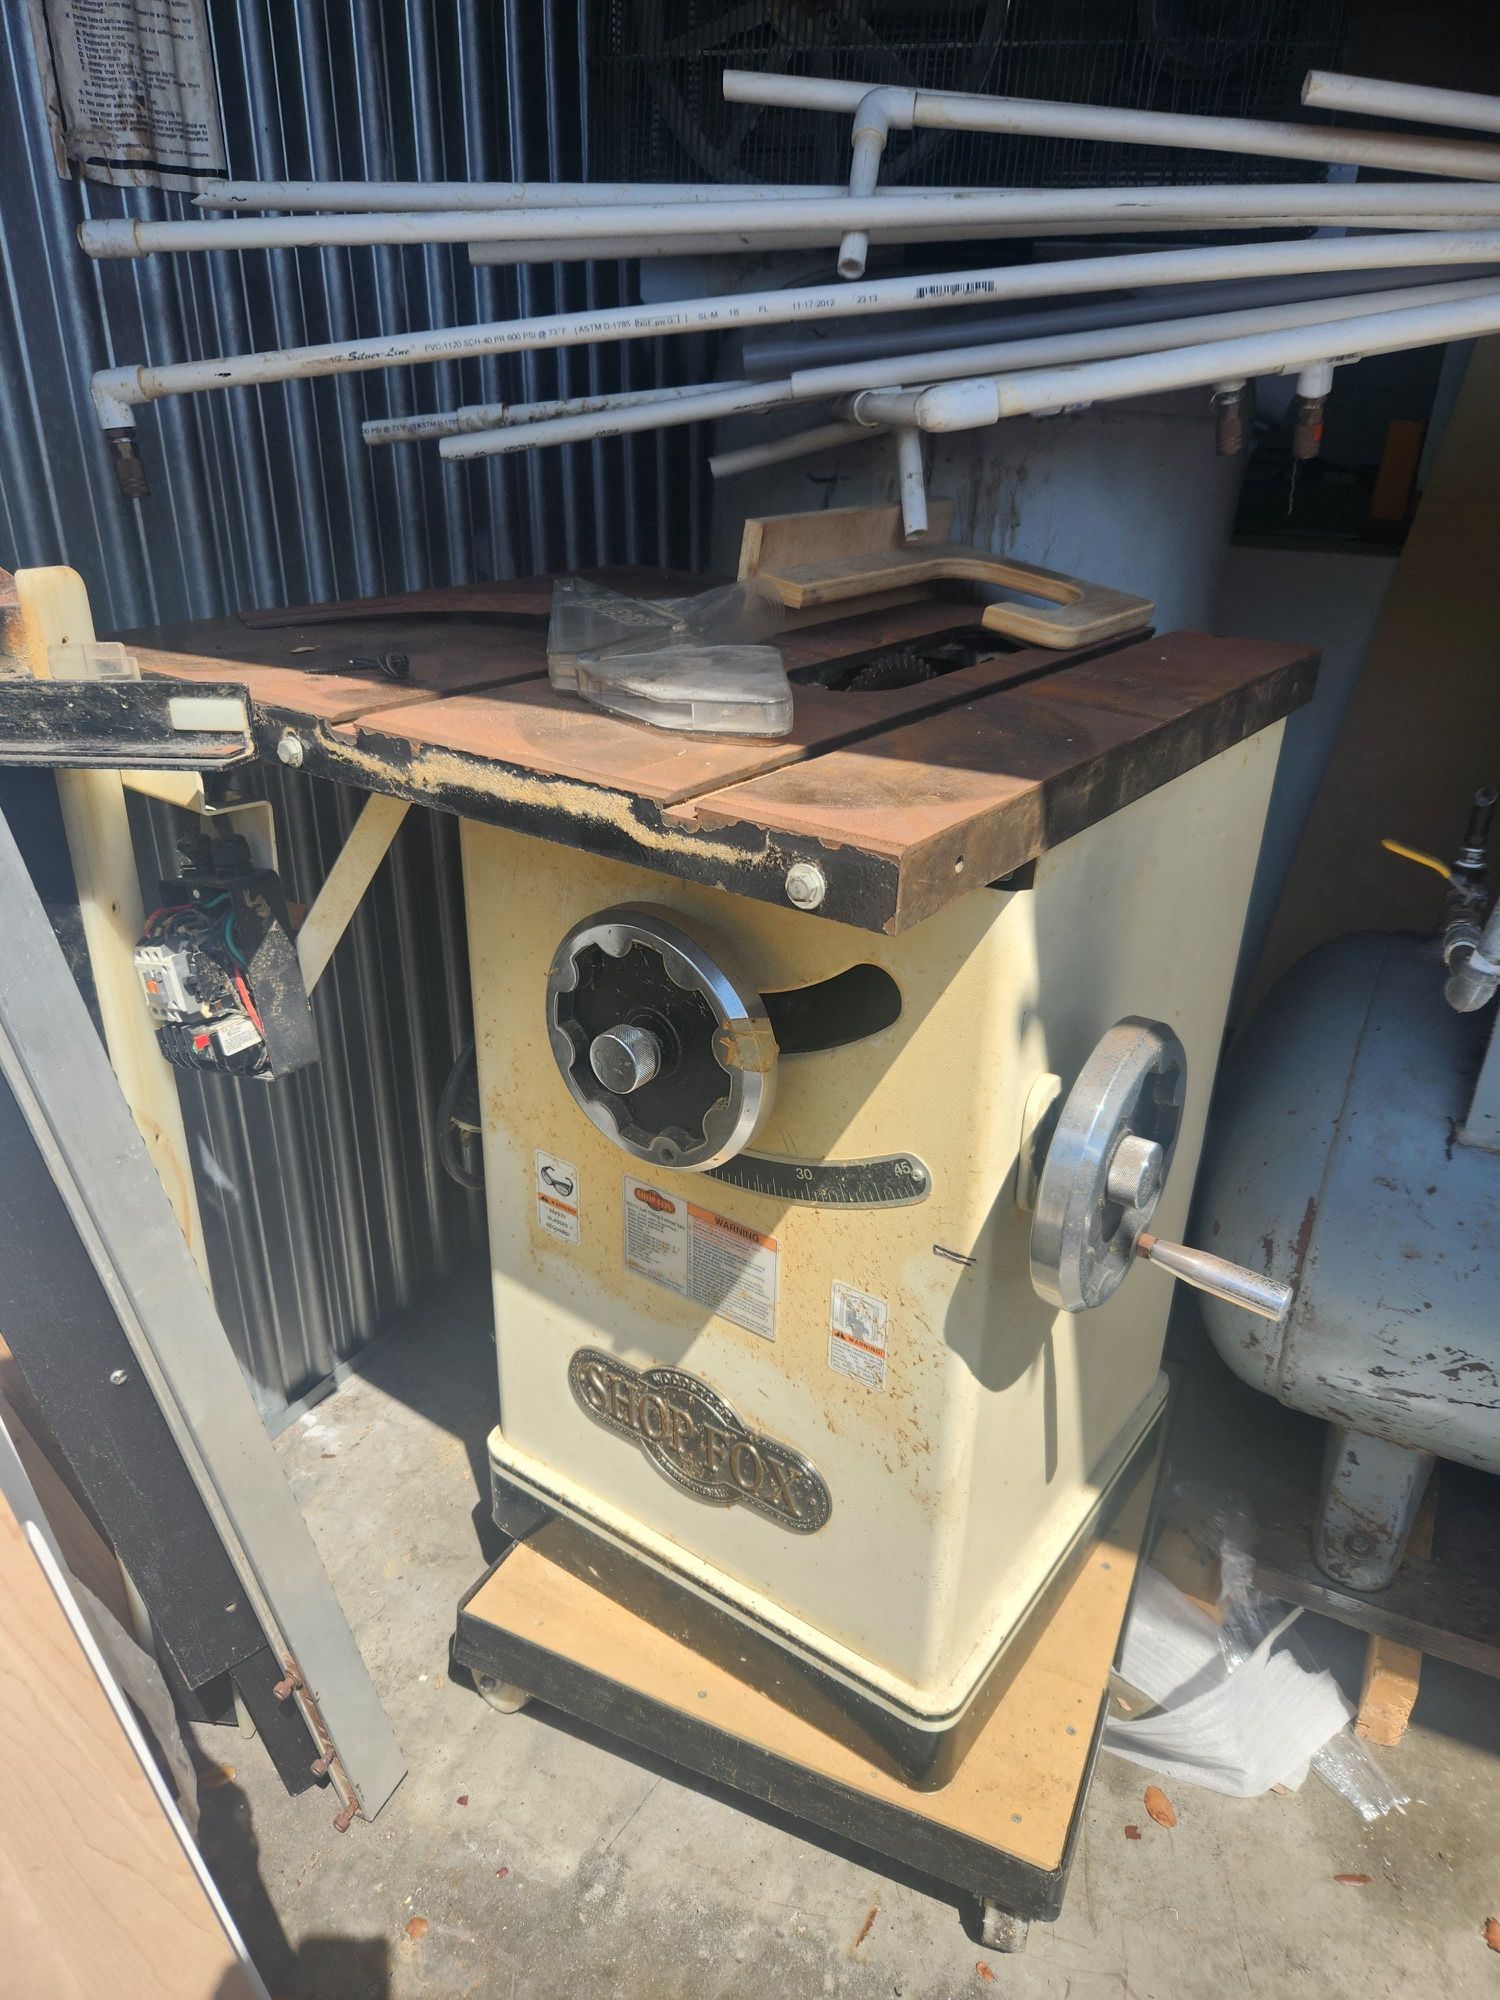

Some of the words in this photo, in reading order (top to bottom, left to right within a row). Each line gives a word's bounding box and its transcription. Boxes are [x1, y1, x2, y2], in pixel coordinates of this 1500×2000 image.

[494, 335, 505, 344] PR
[523, 332, 536, 340] PSI
[796, 1167, 813, 1181] 30
[894, 1161, 912, 1176] 45
[714, 1216, 760, 1244] WARNING
[849, 1337, 883, 1355] WARNING!
[585, 1361, 696, 1453] SHOP
[702, 1422, 804, 1517] FOX
